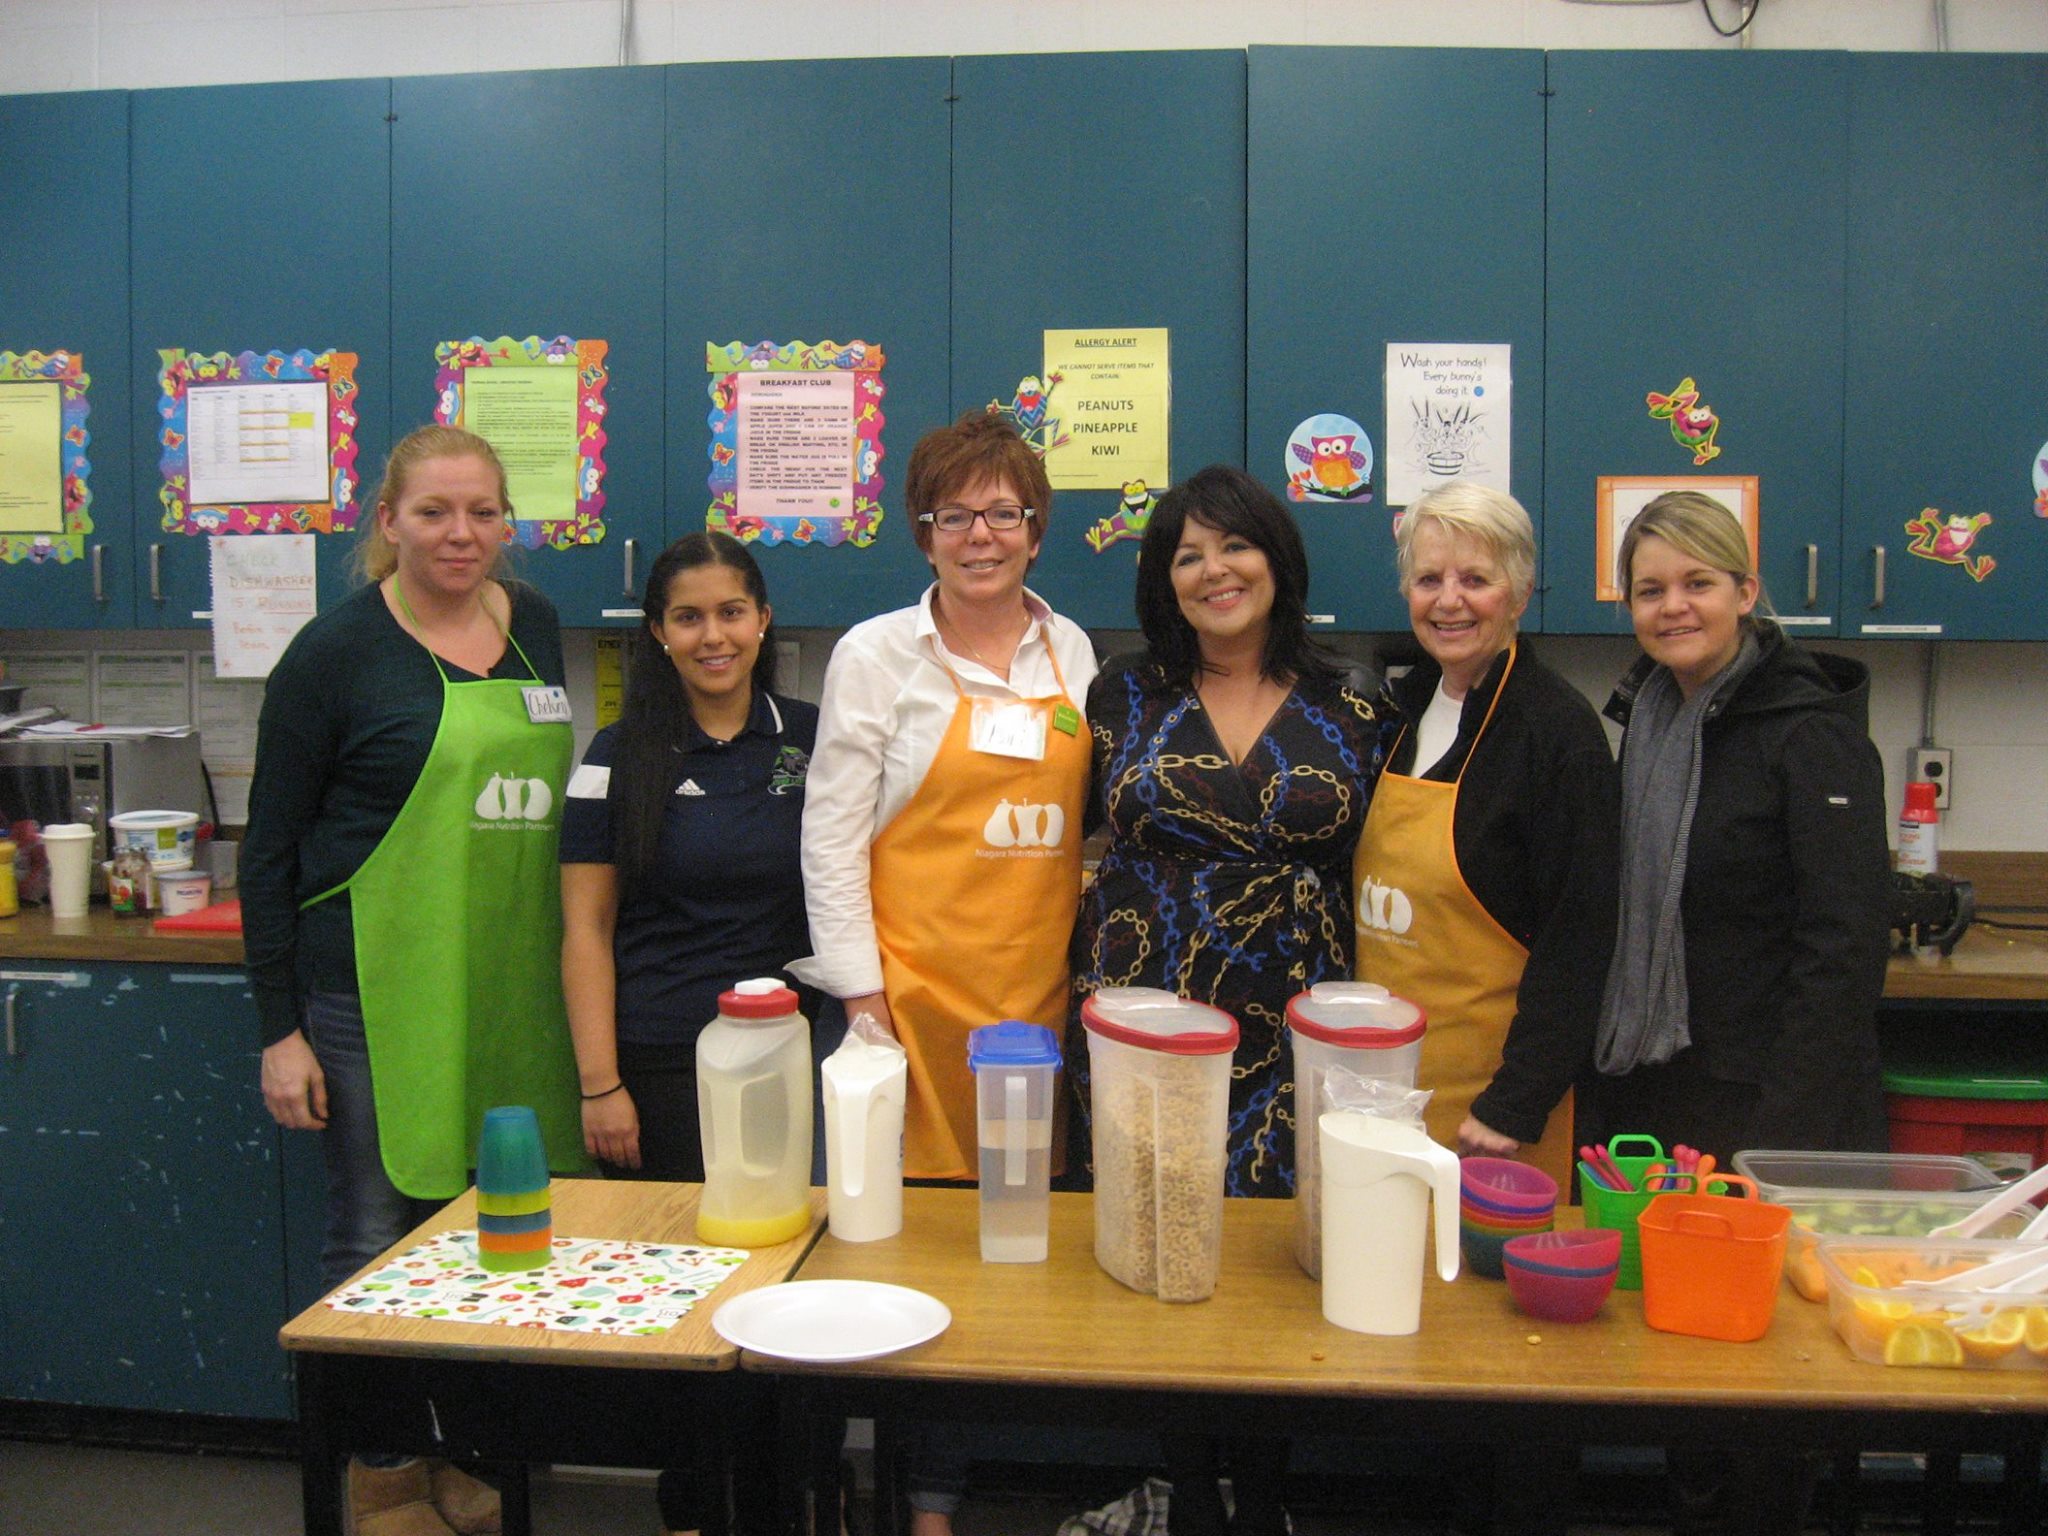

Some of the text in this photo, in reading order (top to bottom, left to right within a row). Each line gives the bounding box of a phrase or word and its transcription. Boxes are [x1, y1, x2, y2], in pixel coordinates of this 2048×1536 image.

[1074, 338, 1138, 347] ALLERGY ALERT
[1138, 362, 1154, 370] THAT
[1400, 352, 1487, 369] Wash your hands!
[1424, 371, 1482, 383] Every bunny's
[1435, 385, 1458, 397] doing
[1078, 400, 1134, 411] PEANUTS
[1073, 422, 1138, 433] PINEAPPLE
[1091, 445, 1120, 456] KIWI
[229, 574, 313, 589] DISHWASHER
